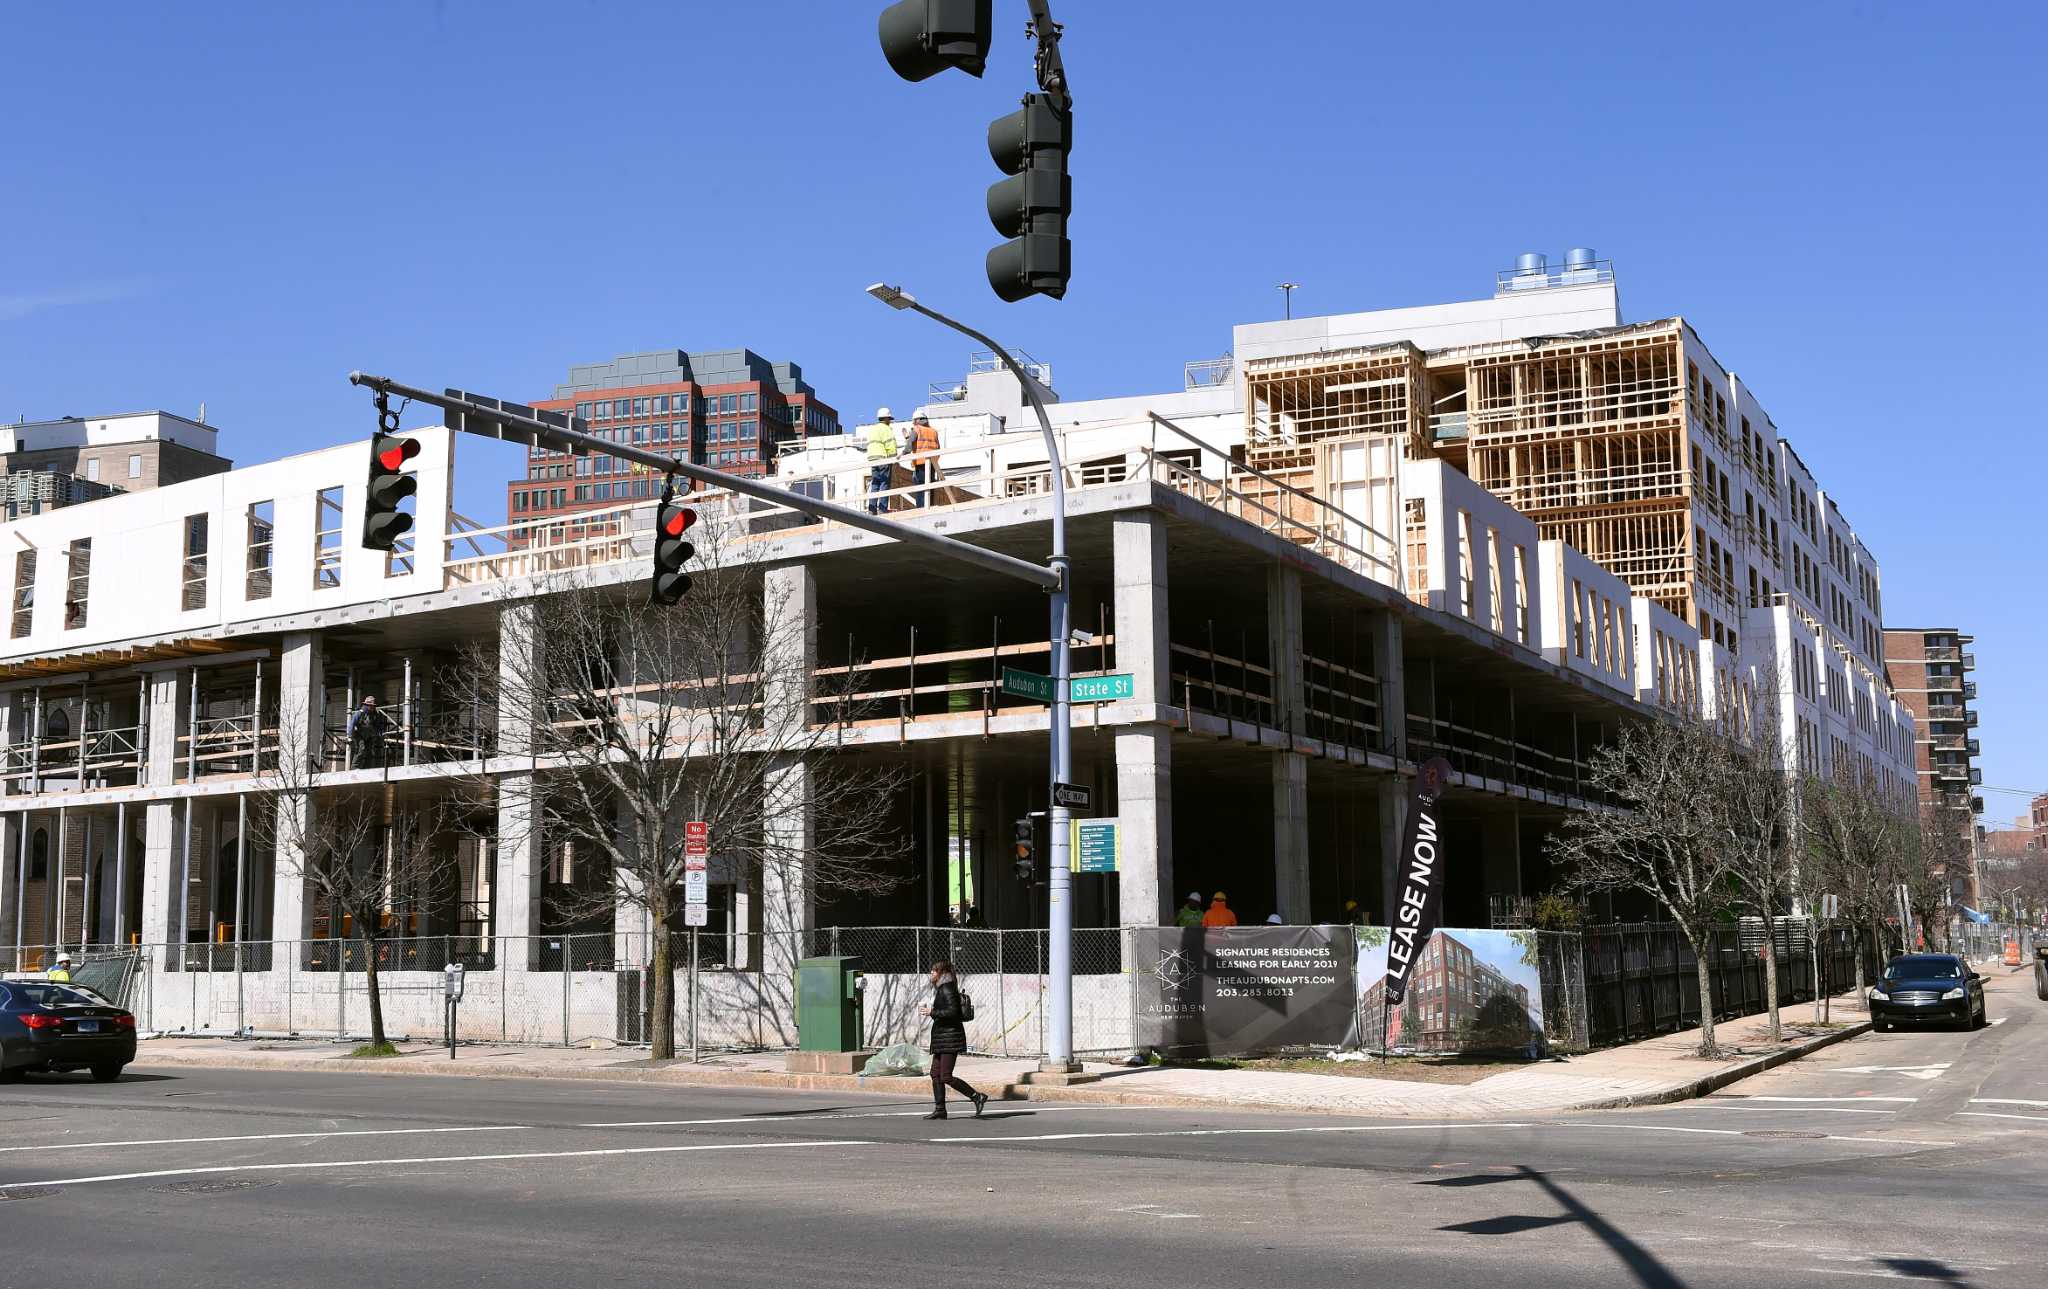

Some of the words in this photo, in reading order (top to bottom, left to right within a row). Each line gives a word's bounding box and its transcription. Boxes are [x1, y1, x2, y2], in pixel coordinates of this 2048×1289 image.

[1040, 681, 1047, 695] St
[1075, 683, 1108, 696] State
[1115, 679, 1128, 693] St
[1058, 790, 1071, 801] ONE
[1073, 792, 1085, 802] WAY
[1389, 886, 1427, 980] LEASE
[1409, 812, 1438, 887] NOW
[1215, 948, 1270, 957] SIGNATURE
[1272, 948, 1331, 956] RESIDENCES
[1169, 962, 1181, 975] A
[1216, 960, 1257, 969] LEASING
[1259, 960, 1279, 968] FOR
[1281, 960, 1310, 968] EARLY
[1313, 960, 1338, 968] 2019
[1216, 976, 1335, 985] THEAUDUBONAPTS.COM
[1216, 987, 1294, 997] 203.285.8013
[1148, 1004, 1206, 1013] AUDUBON
